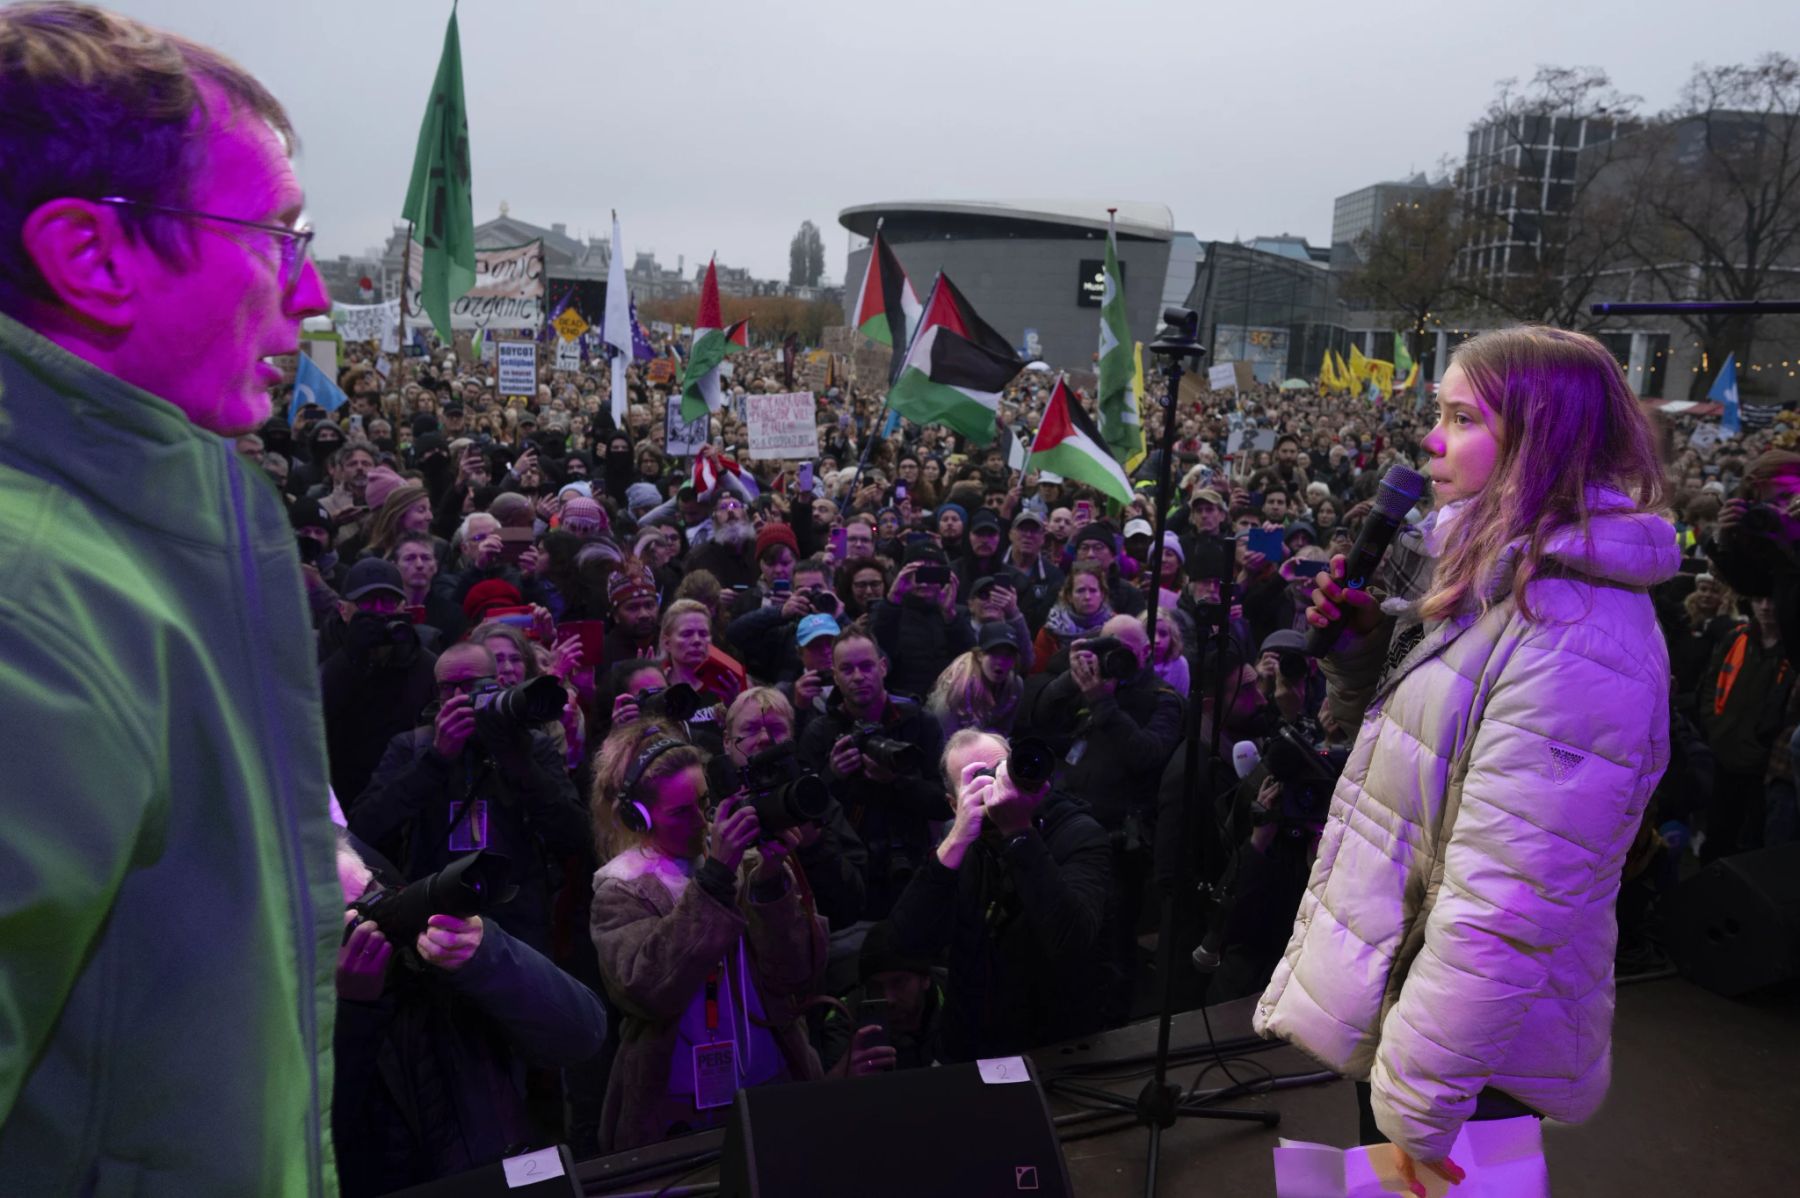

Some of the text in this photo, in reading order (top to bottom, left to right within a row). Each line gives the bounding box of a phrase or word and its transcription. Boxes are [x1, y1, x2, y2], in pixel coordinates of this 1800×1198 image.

[559, 318, 583, 328] DEAD
[560, 327, 580, 336] END
[500, 346, 534, 357] BOYCOT
[698, 1049, 732, 1069] PERS
[996, 1064, 1010, 1079] 2
[524, 1159, 544, 1176] 2
